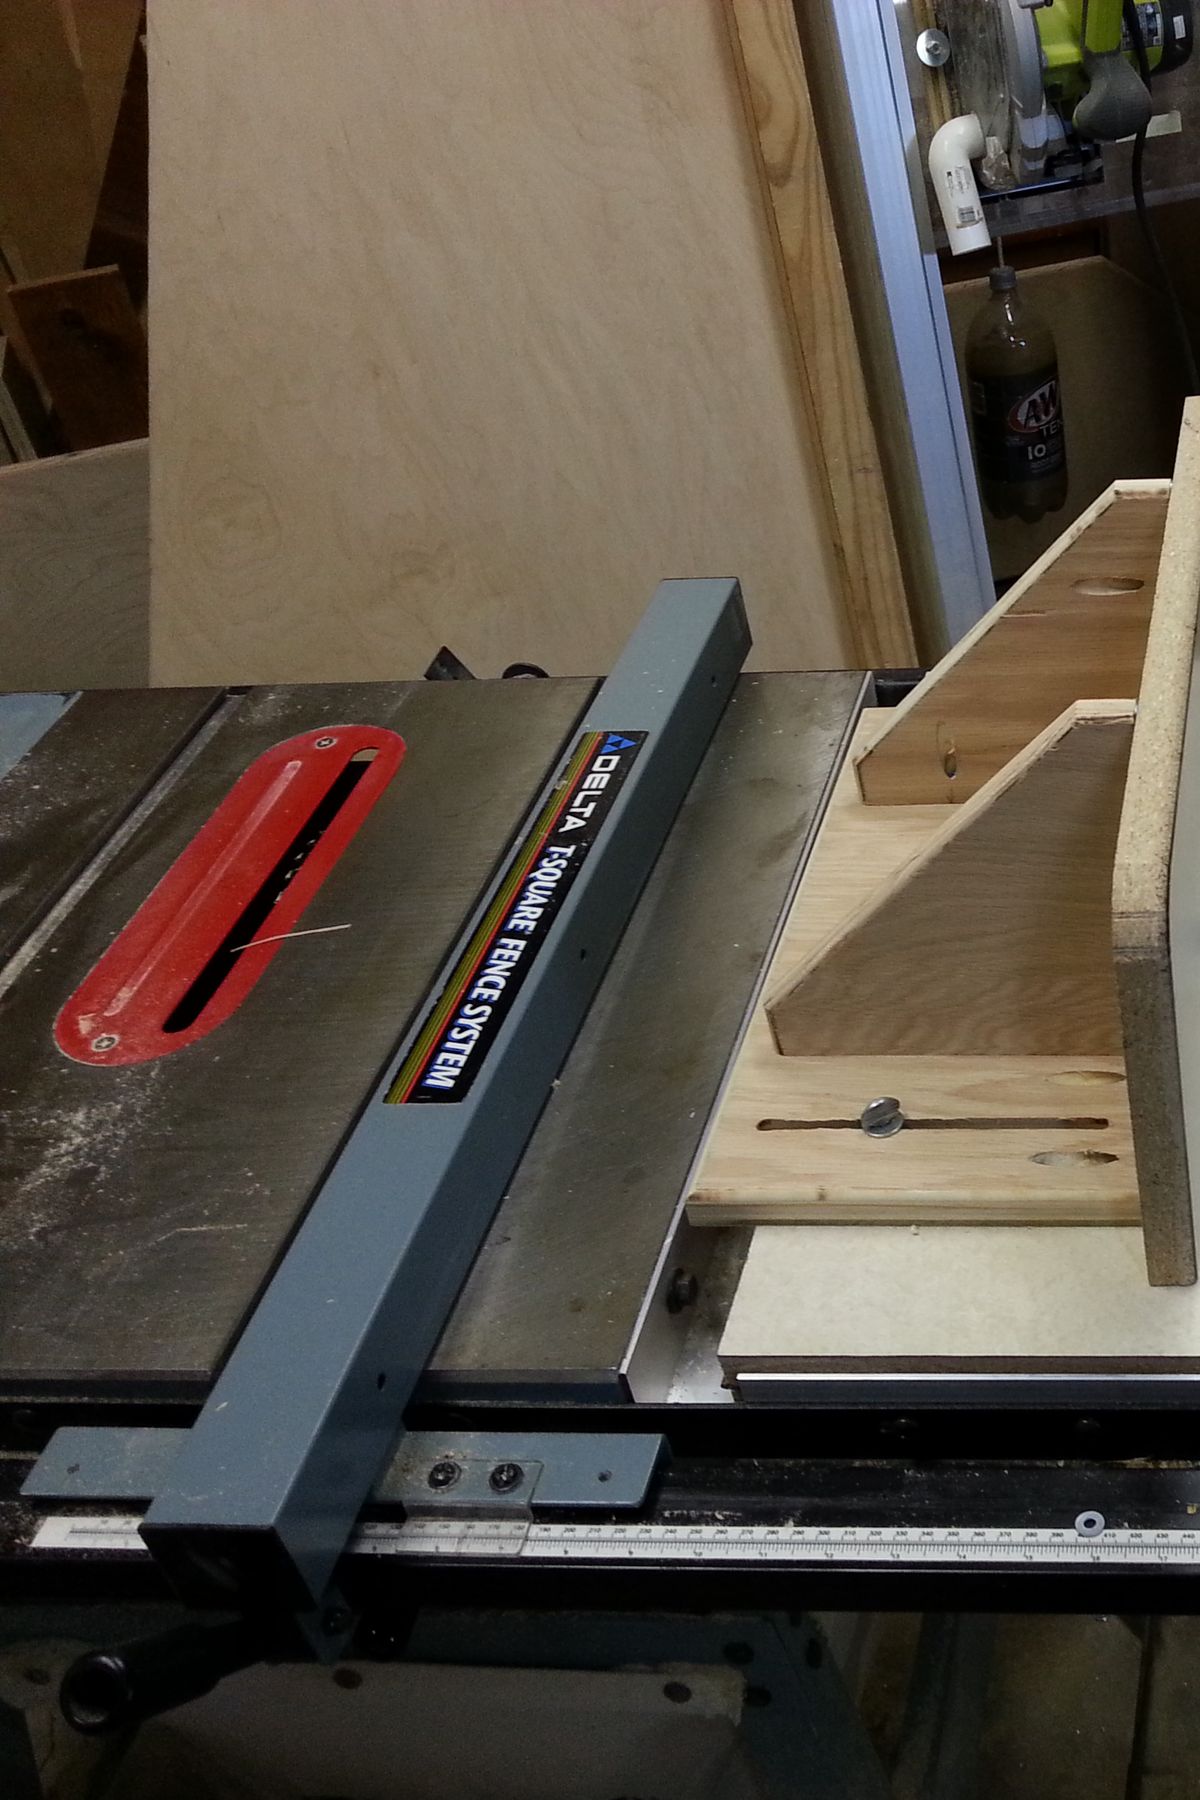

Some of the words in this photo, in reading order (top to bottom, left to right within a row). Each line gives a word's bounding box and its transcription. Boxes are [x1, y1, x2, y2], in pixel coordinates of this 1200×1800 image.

[558, 754, 621, 833] DELTA
[466, 936, 528, 1001] FENCE
[420, 1003, 493, 1090] SYSTEM
